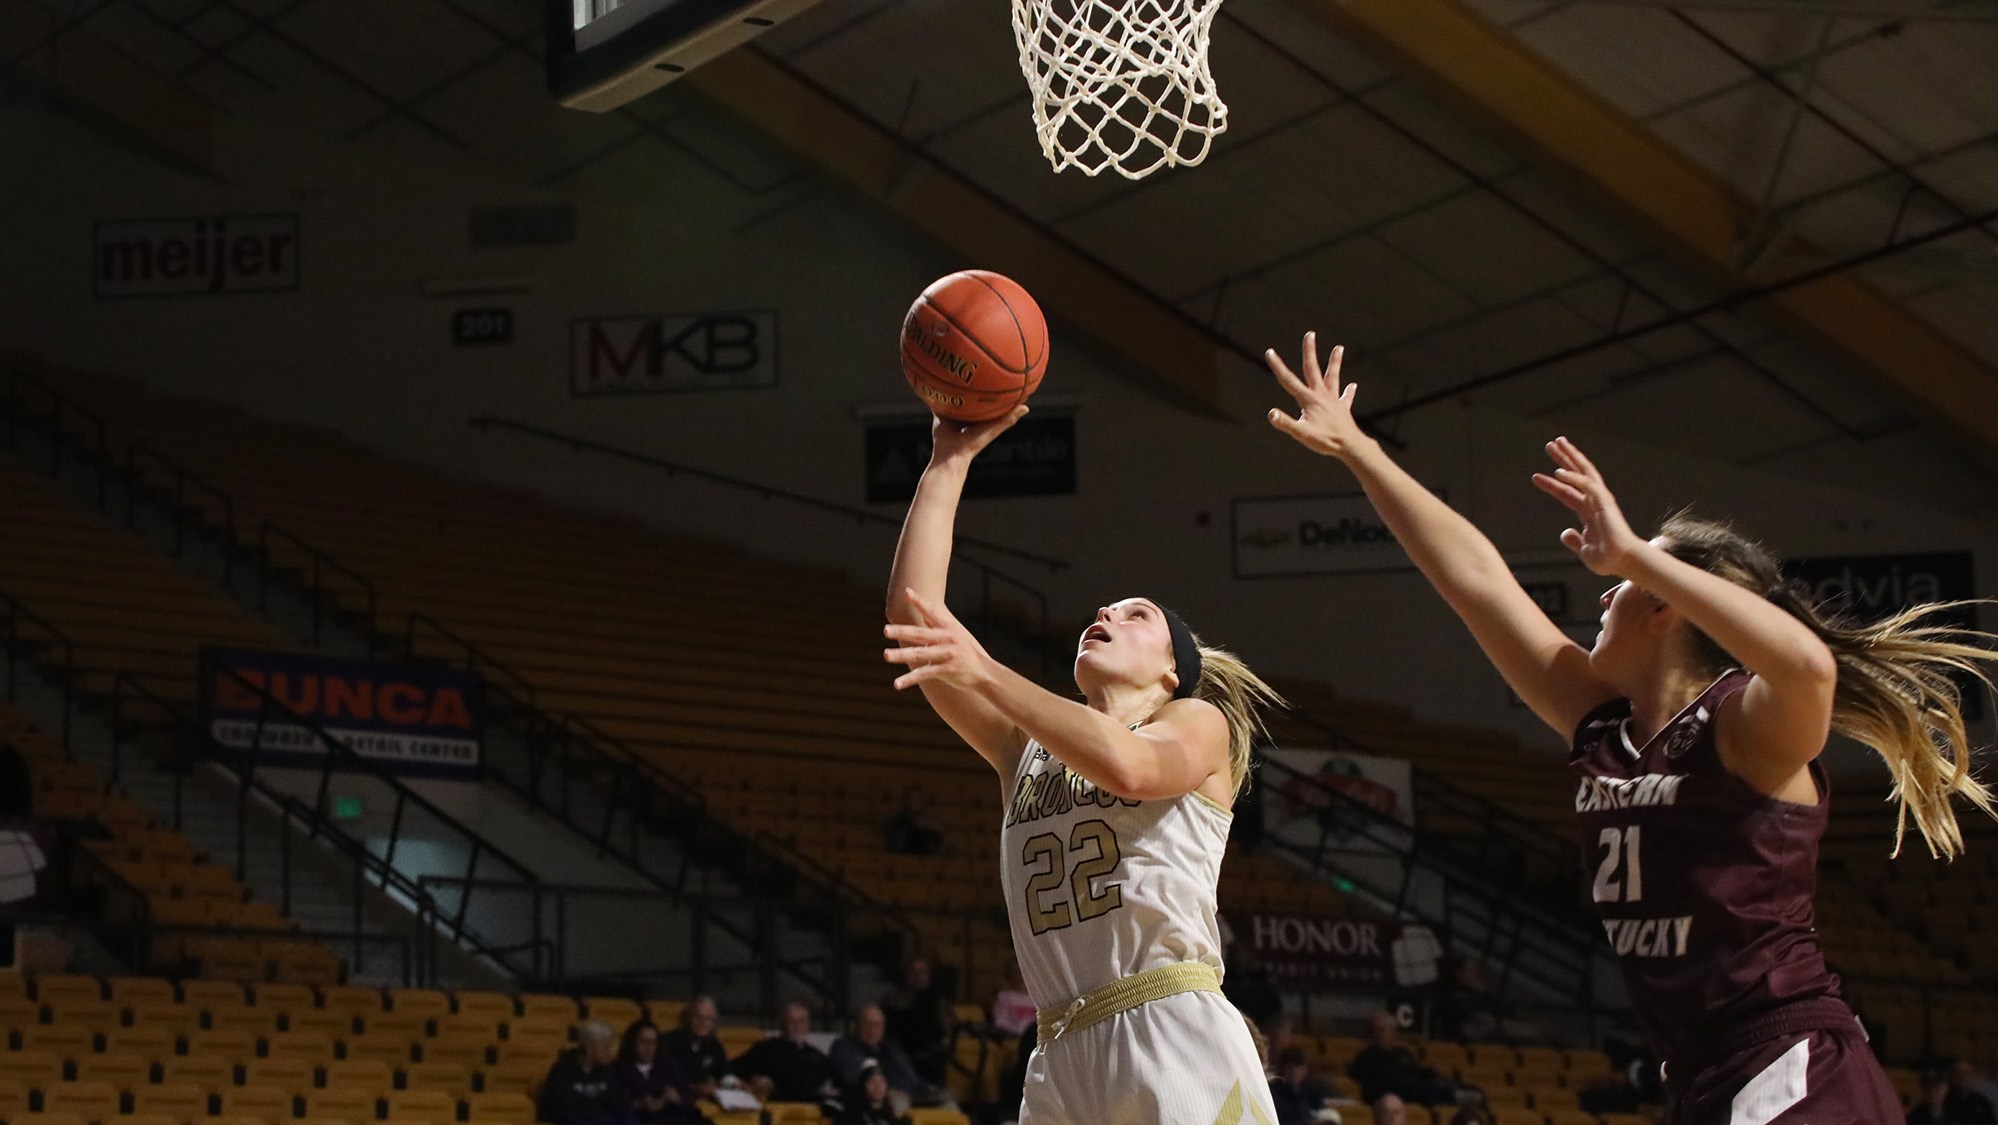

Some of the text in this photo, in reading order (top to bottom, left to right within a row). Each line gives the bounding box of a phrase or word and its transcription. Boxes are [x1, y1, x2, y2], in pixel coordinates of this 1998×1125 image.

[101, 217, 290, 292] meijer
[461, 313, 504, 339] 201
[588, 314, 760, 379] MKB
[214, 667, 473, 730] BUNCA
[1022, 818, 1123, 937] 22
[1592, 824, 1643, 904] 21
[1253, 914, 1382, 957] HONOR
[1601, 915, 1694, 958] TUCKY
[1396, 1003, 1415, 1029] C
